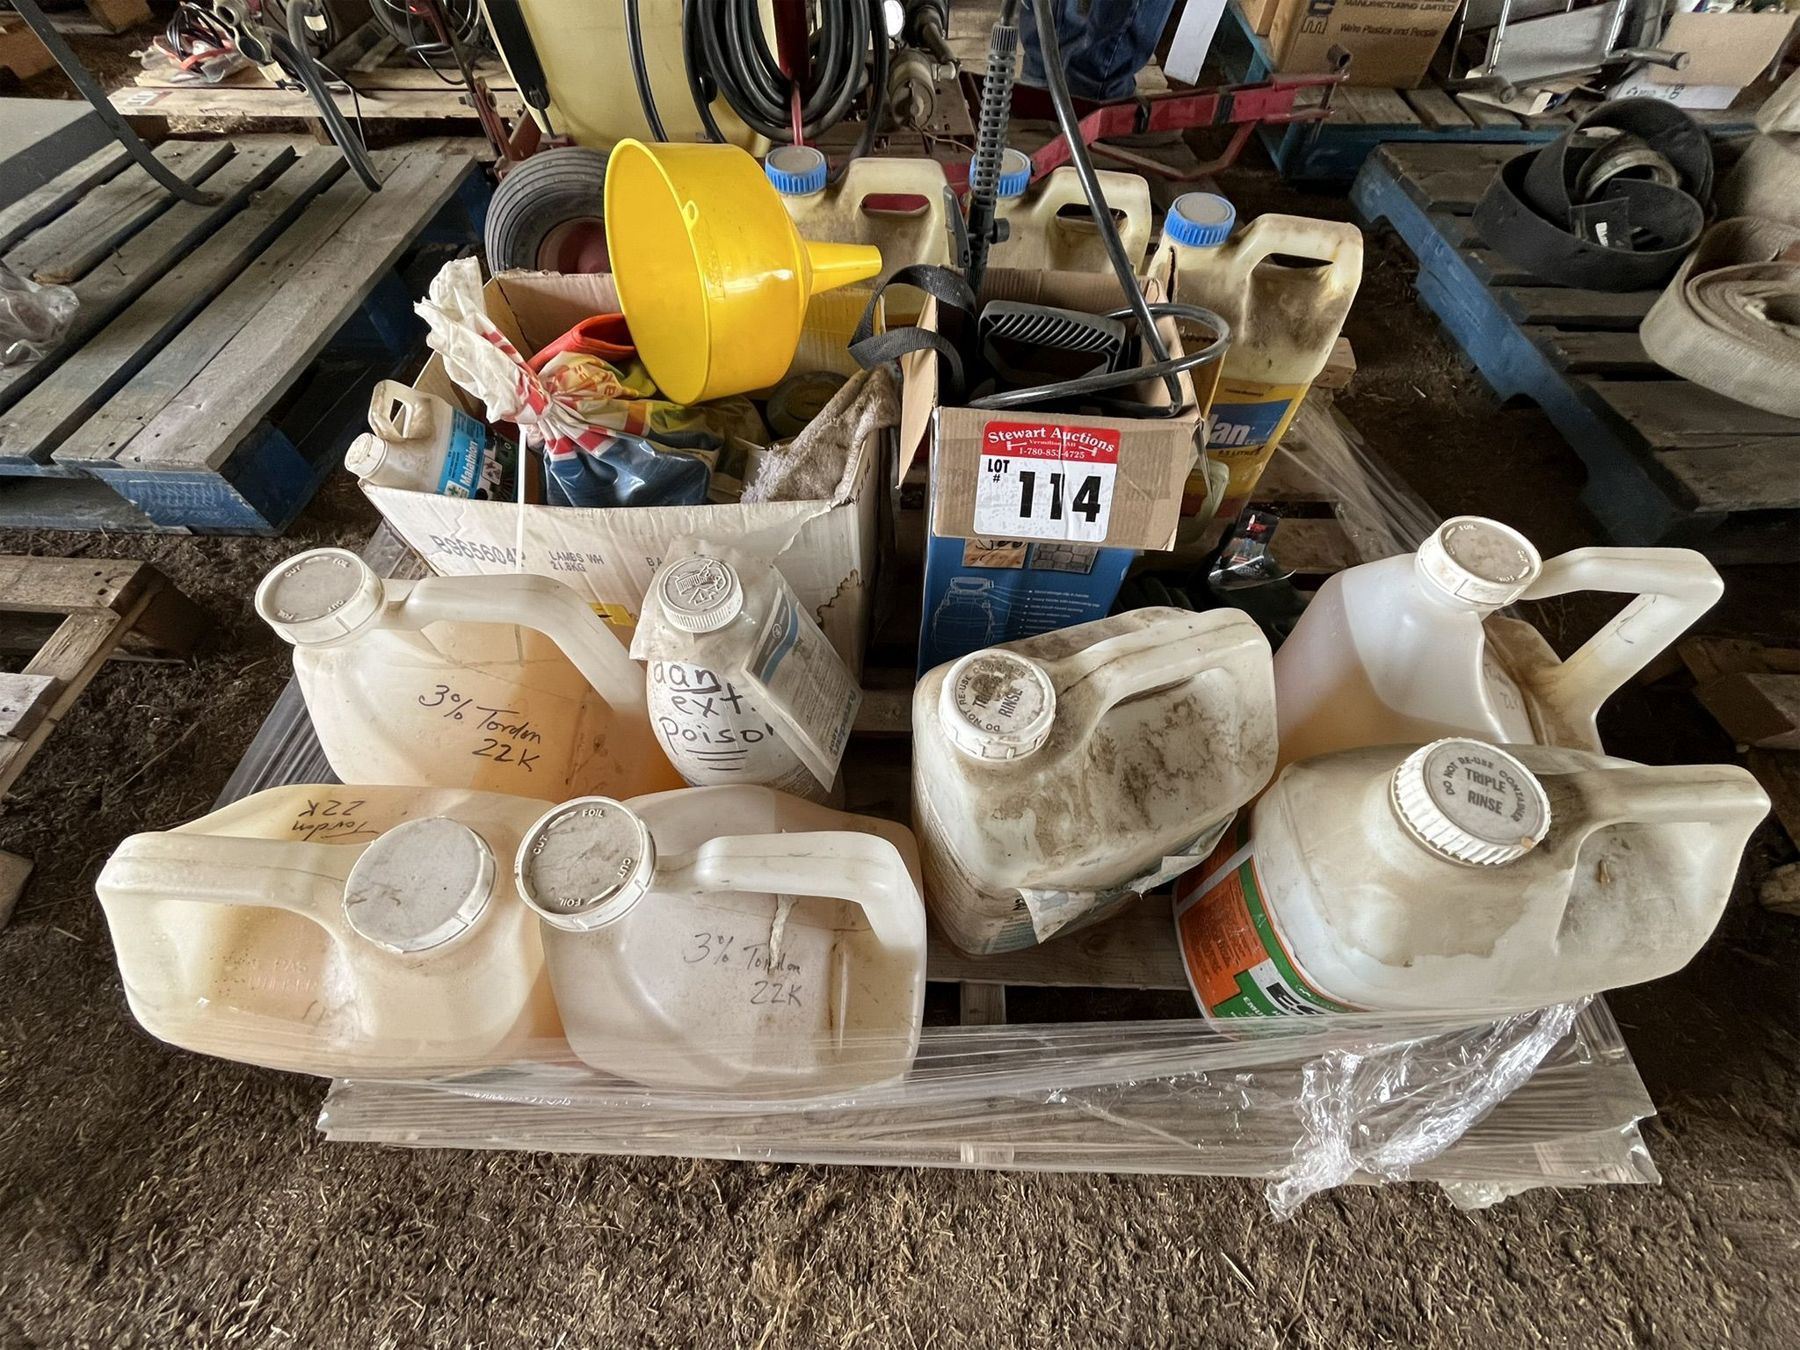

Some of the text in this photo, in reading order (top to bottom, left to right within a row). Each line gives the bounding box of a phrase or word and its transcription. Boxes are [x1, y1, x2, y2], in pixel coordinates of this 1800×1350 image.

[988, 427, 1115, 453] Stewart Auctions
[1208, 413, 1251, 446] lan
[459, 440, 478, 487] Malathion
[987, 458, 1010, 473] LOT
[1019, 470, 1102, 523] 114
[548, 550, 585, 563] LAMBS
[284, 564, 302, 578] CUT
[418, 684, 473, 720] 3%
[998, 687, 1024, 718] RINSE
[963, 710, 983, 728] NOT
[1443, 761, 1459, 779] NOT
[1464, 767, 1507, 794] TRIPLE
[1442, 780, 1456, 796] DO
[1467, 790, 1504, 815] RINSE
[532, 809, 606, 855] CUT FOIL
[558, 858, 632, 907] CUT FOIL
[682, 932, 735, 966] 3%
